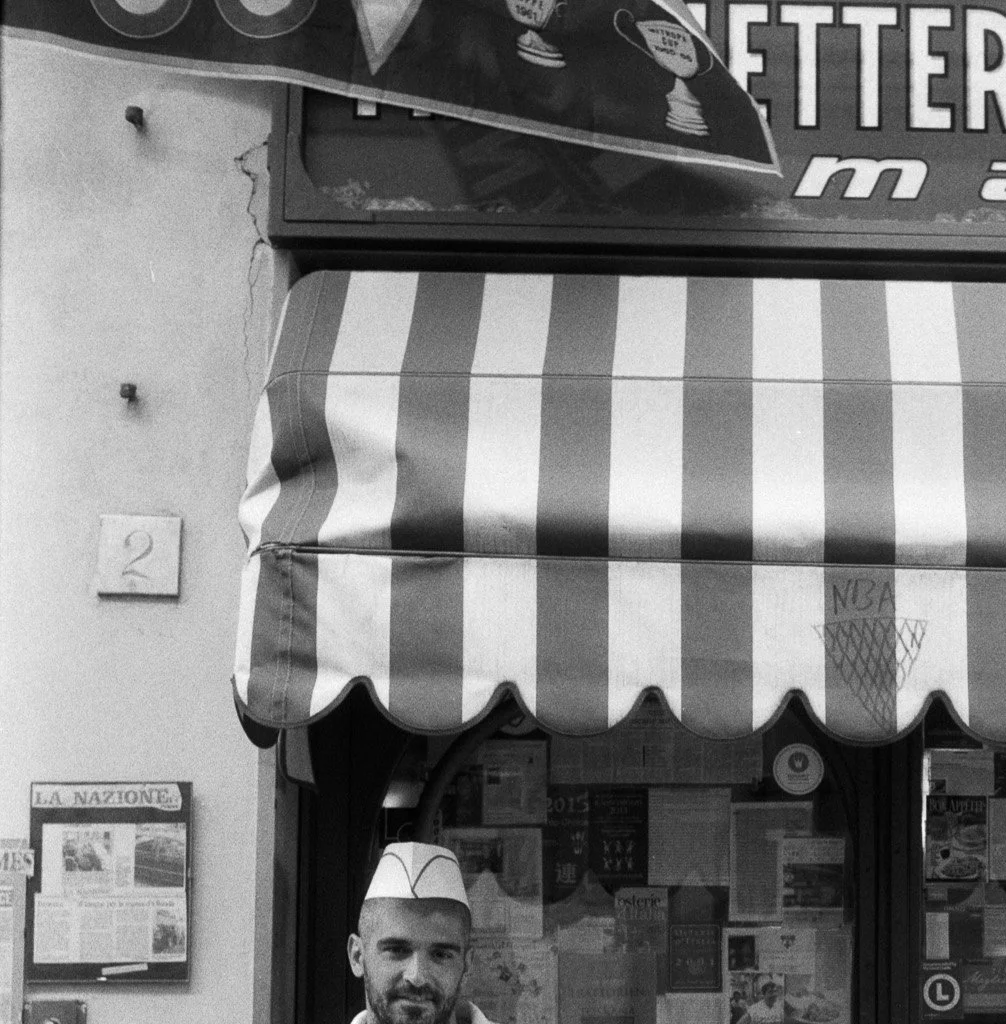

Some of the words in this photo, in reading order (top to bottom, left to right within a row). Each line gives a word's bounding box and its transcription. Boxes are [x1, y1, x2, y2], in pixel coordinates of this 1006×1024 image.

[515, 5, 537, 22] 1961
[122, 529, 154, 579] 2
[833, 579, 895, 614] NBA
[34, 788, 63, 807] LA
[73, 787, 171, 808] NAZIONE
